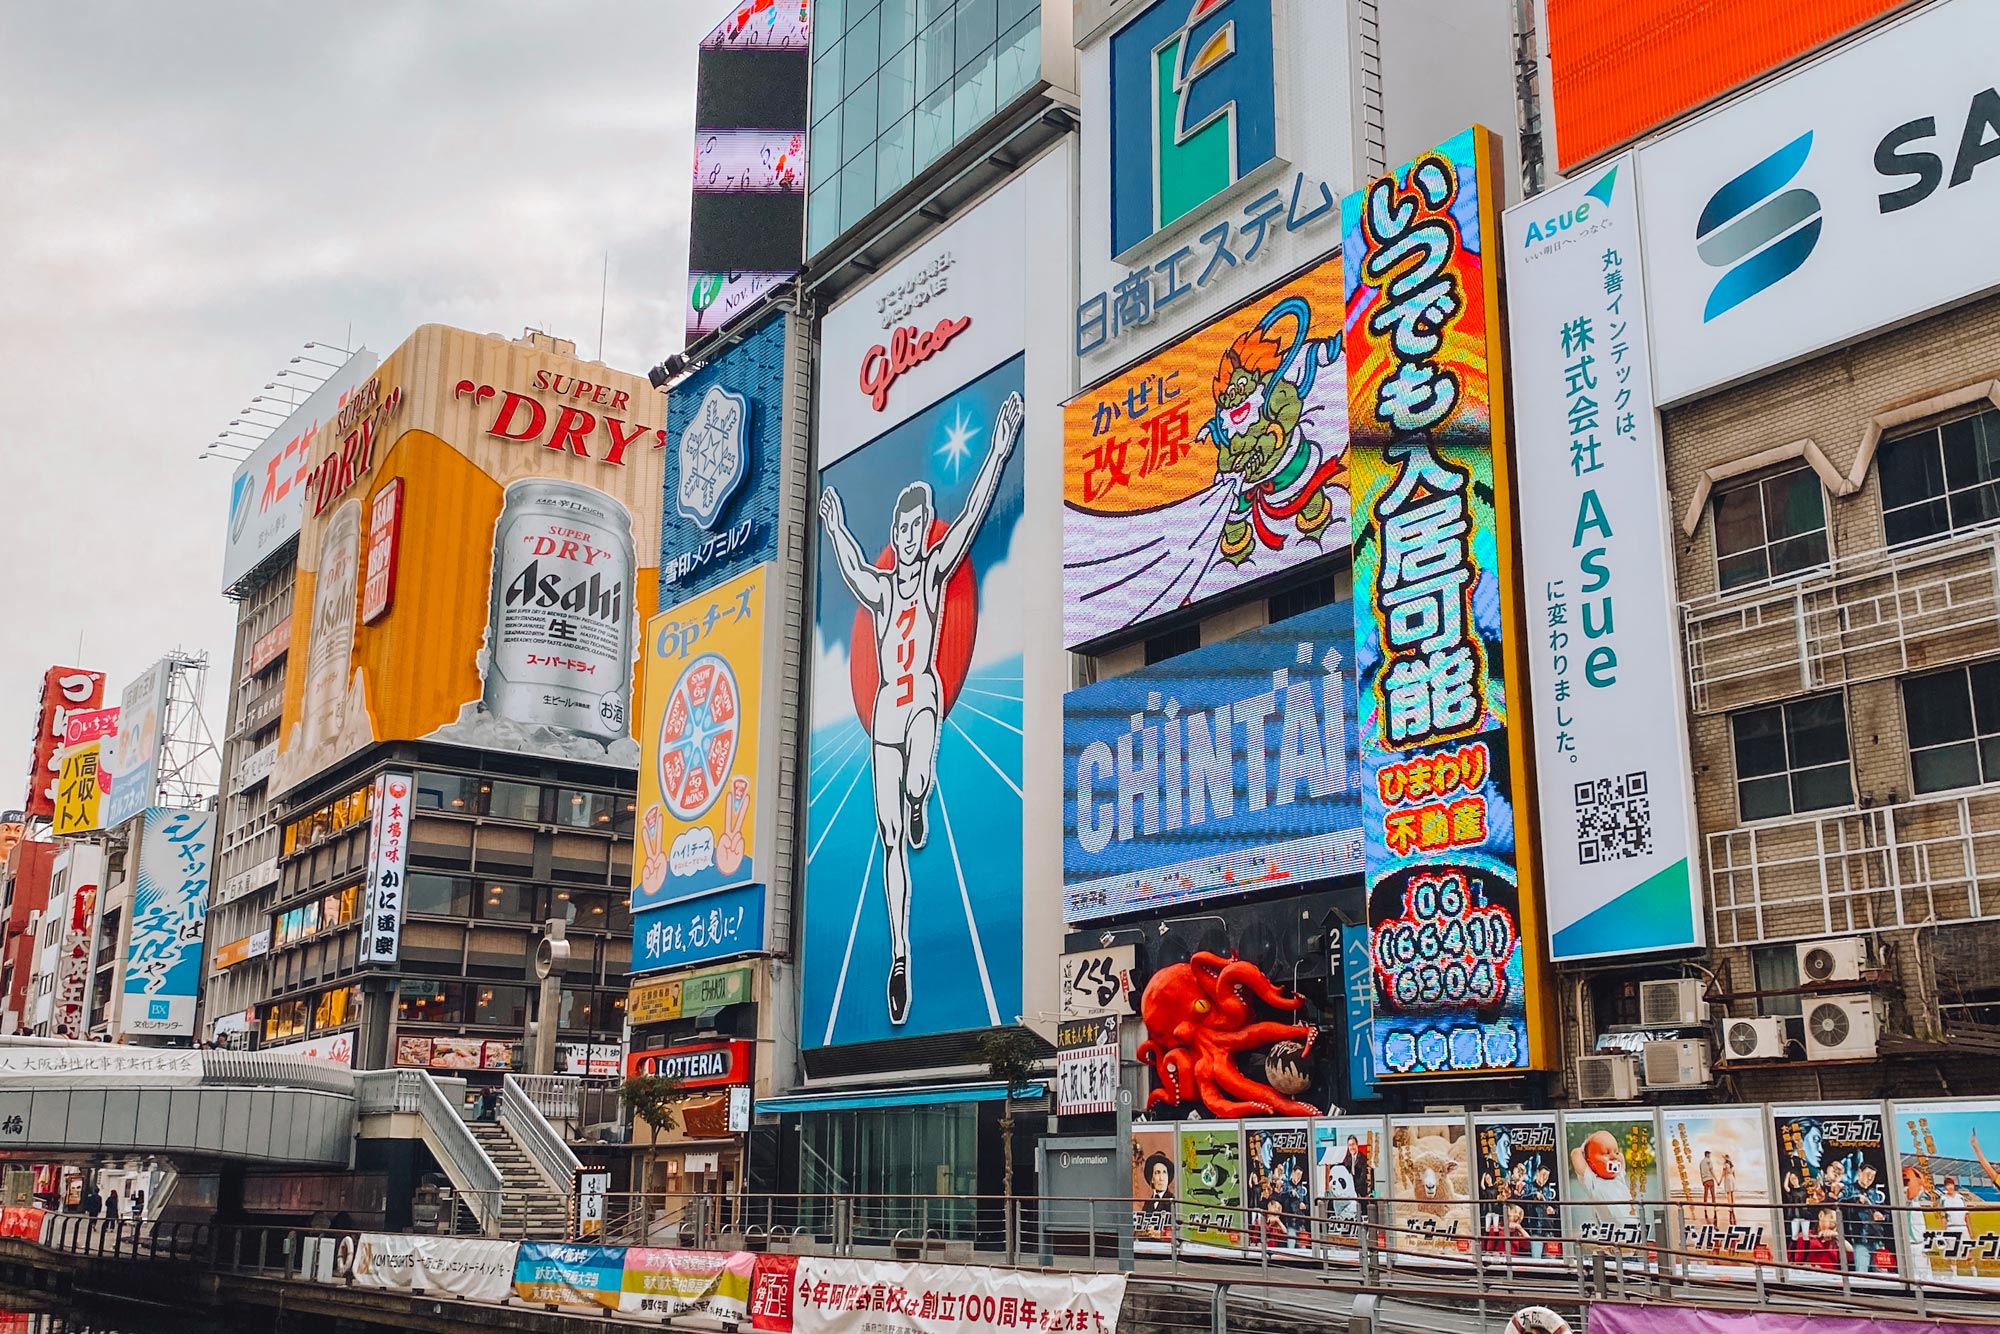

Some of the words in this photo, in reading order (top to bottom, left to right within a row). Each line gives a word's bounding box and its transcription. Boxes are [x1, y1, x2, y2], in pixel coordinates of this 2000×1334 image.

[1525, 203, 1590, 248] Asue
[1077, 172, 1333, 357] 日商エステム
[860, 315, 973, 412] Glico
[1601, 247, 1637, 442] 丸善インテックは、
[335, 376, 379, 438] SUPER
[532, 369, 630, 412] SUPER
[1092, 370, 1180, 437] かぜに
[1560, 315, 1604, 477] 株式会社
[1083, 399, 1191, 503] 改源
[1371, 158, 1478, 742] いつでも入居可能
[548, 526, 591, 542] SUPER
[664, 518, 752, 585] 雪印メグミルク
[505, 559, 621, 624] Asahi
[1572, 488, 1618, 689] Asue
[548, 619, 577, 641] 生
[896, 600, 918, 707] グリコ
[527, 654, 596, 675] スーパードライ
[691, 668, 711, 685] SNOW
[1546, 579, 1578, 764] に変わりました。
[601, 701, 623, 724] お酒
[61, 755, 82, 829] バイト
[75, 752, 99, 826] 高収入
[1380, 743, 1488, 807] ひまわり
[385, 804, 404, 863] 本場の味
[1386, 798, 1487, 856] 不動産
[163, 814, 209, 941] シャッターは
[1414, 878, 1463, 920] 06
[375, 870, 399, 955] かに道楽
[152, 1005, 166, 1015] BX
[1396, 959, 1494, 1003] 6304
[133, 1020, 183, 1029] 文化シャッター
[24, 1056, 191, 1072] 大阪活性化事業実行委員会
[659, 1053, 723, 1079] LOTTERIA
[2, 1115, 23, 1136] 橋
[1071, 1155, 1109, 1165] information
[1548, 1182, 1557, 1199] 5
[1875, 1184, 1885, 1203] 5
[550, 1247, 588, 1263] 東大阪大学
